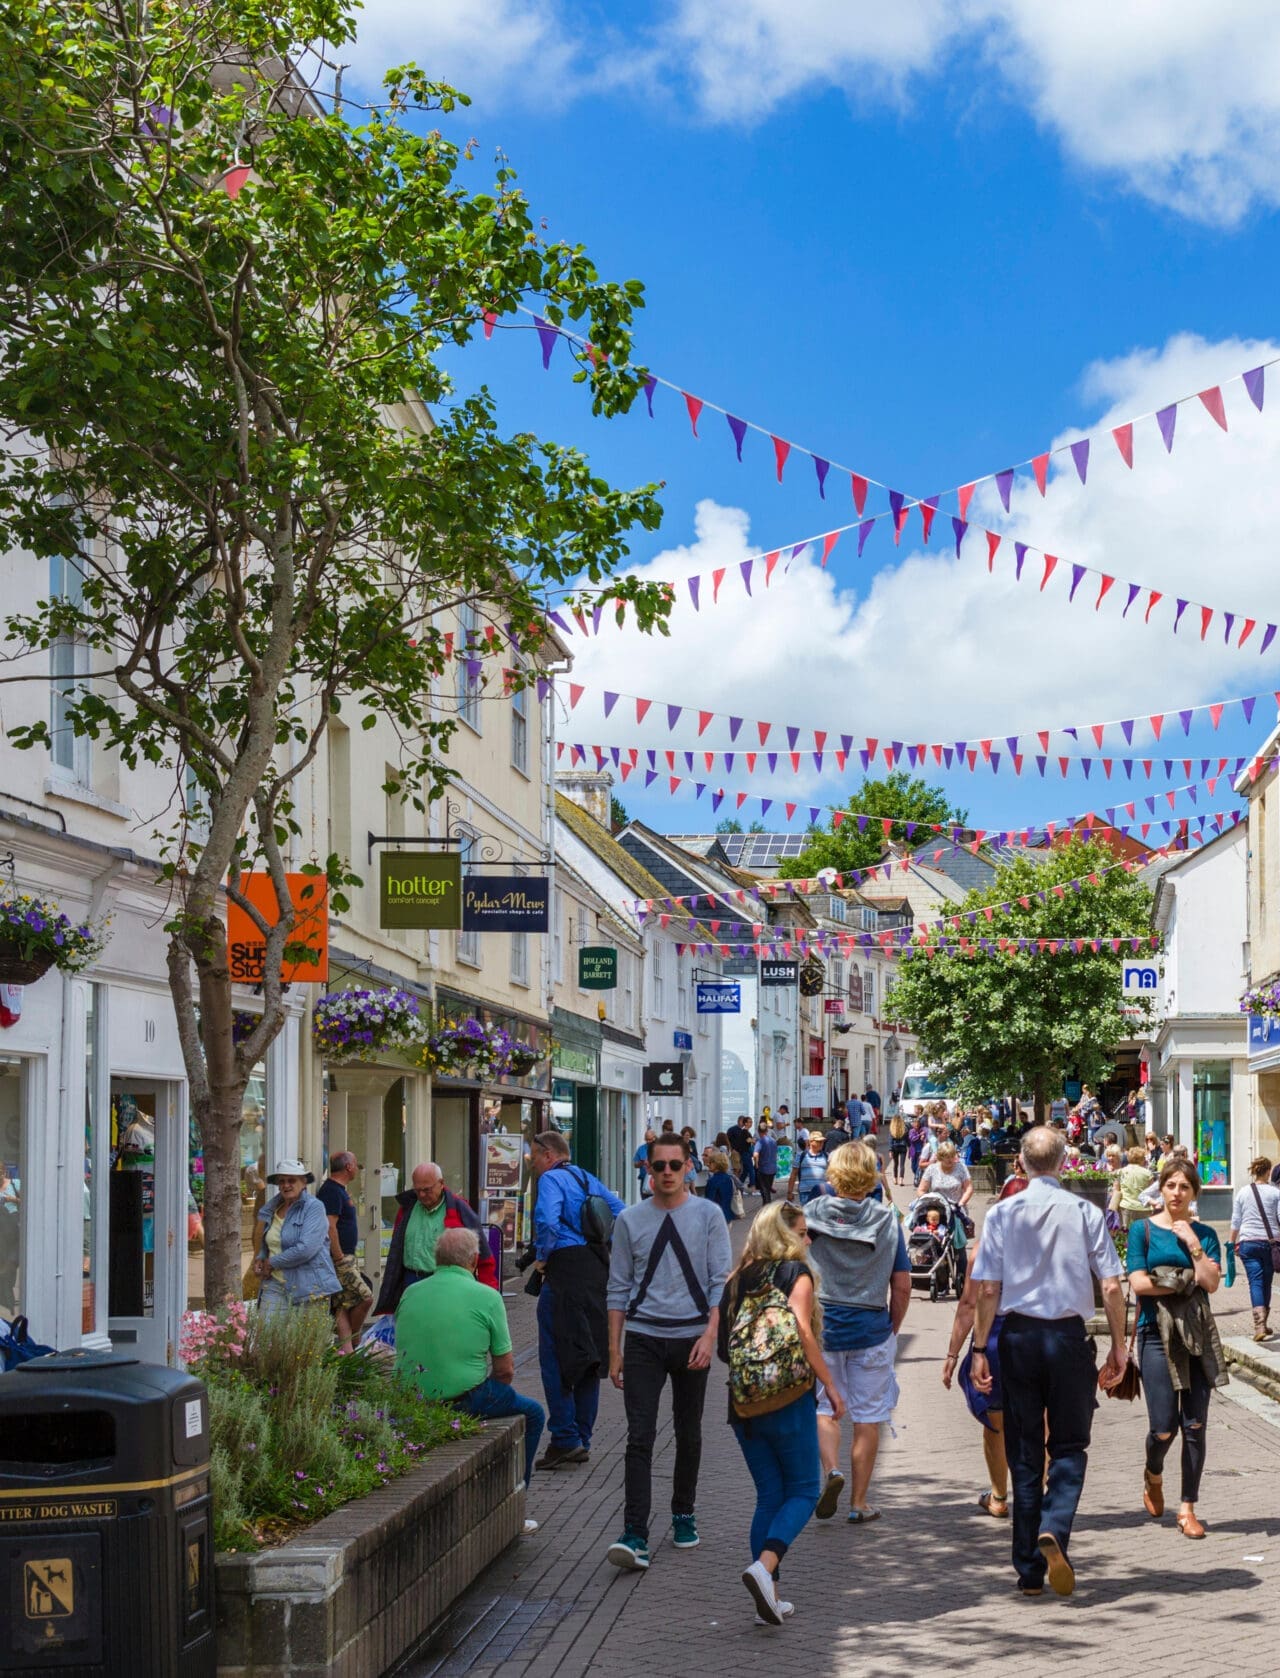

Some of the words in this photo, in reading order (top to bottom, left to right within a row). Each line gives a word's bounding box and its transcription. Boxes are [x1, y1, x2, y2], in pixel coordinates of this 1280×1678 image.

[388, 876, 453, 896] hotter
[466, 891, 500, 914] Pydar
[502, 892, 544, 909] Mews
[231, 960, 285, 978] Sto.
[583, 957, 613, 966] HOLLAND
[583, 971, 613, 979] BARRETT
[762, 967, 795, 977] LUSH
[698, 994, 739, 1003] HALIFAX
[145, 1020, 155, 1042] 10
[41, 1505, 68, 1518] DOG
[71, 1503, 113, 1516] WASTE
